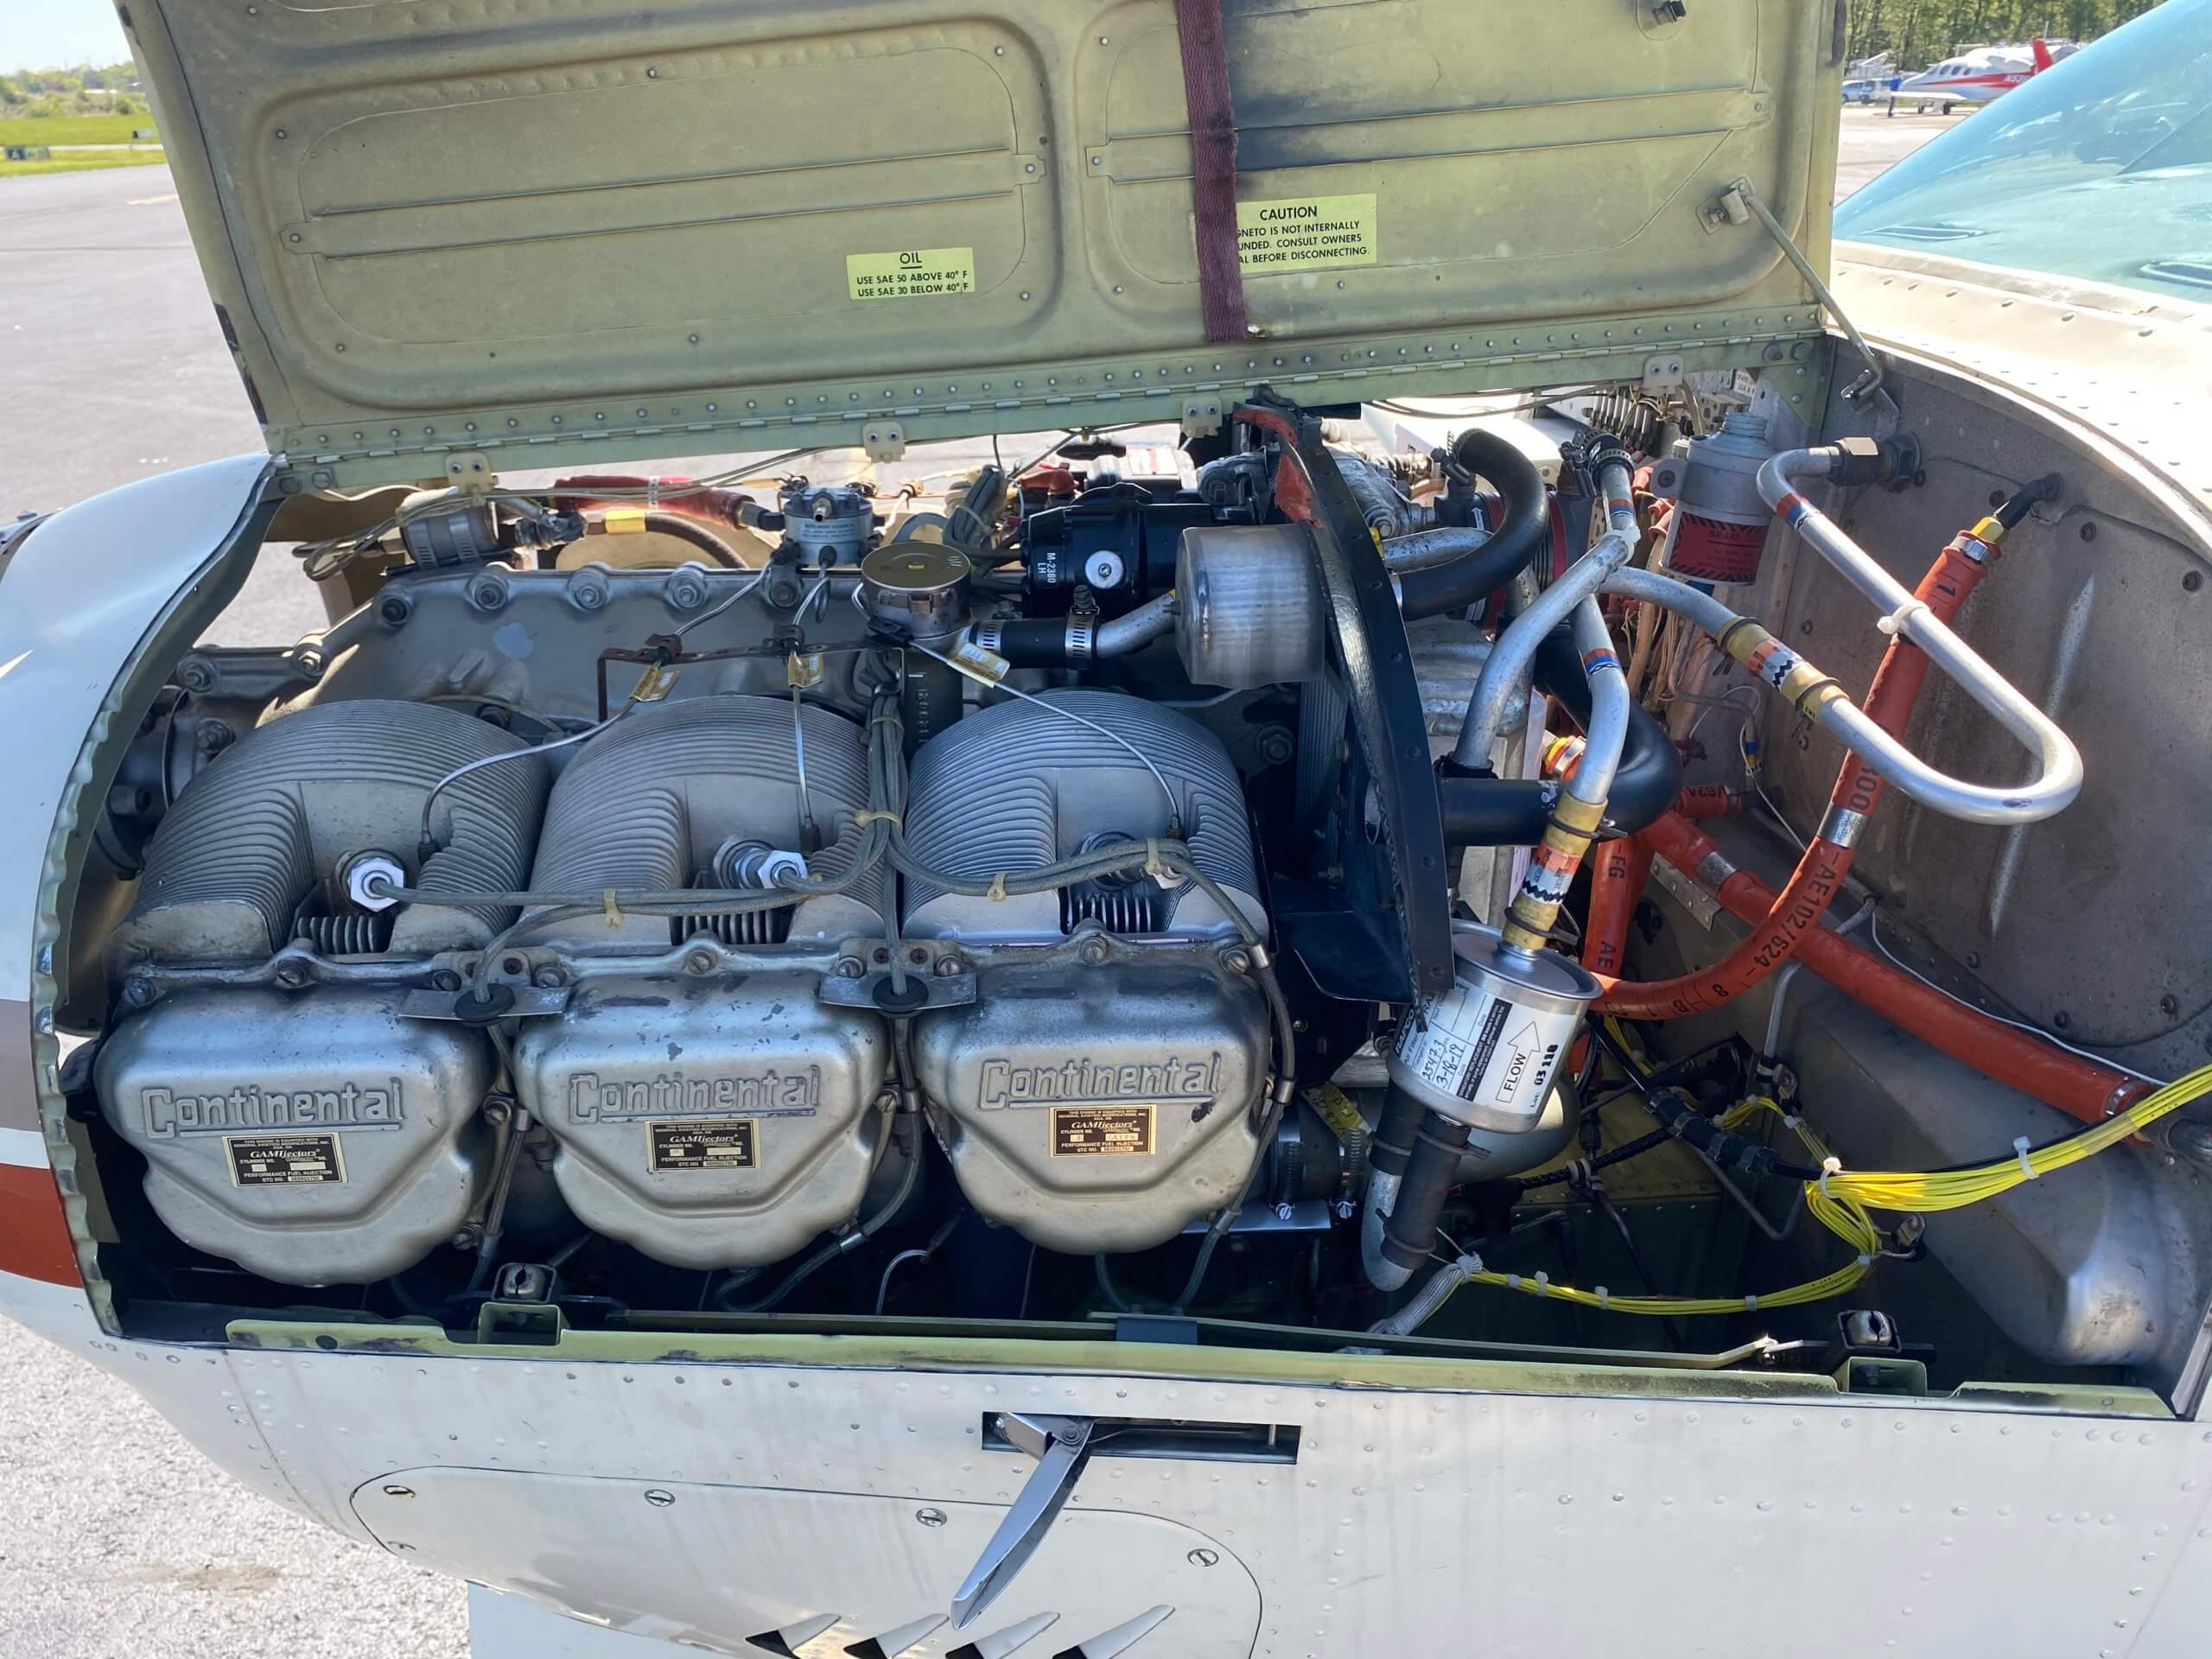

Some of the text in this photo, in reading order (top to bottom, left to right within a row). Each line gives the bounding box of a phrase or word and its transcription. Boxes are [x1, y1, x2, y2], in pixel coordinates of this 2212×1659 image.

[1260, 206, 1318, 220] CAUTION
[1236, 220, 1360, 238] GNETO IS NOT INTERNALLY
[1238, 233, 1362, 251] UNDED. CONSULT OWNERS
[899, 252, 923, 264] OIL
[1253, 253, 1287, 263] BEFORE
[1291, 246, 1370, 260] DISCONNECTING.
[856, 276, 873, 284] USE
[877, 275, 893, 283] SAE
[897, 274, 907, 283] 50
[910, 271, 942, 282] ABOVE
[878, 287, 894, 296] SAE
[898, 286, 907, 295] 30
[911, 284, 943, 294] BELOW
[963, 283, 969, 291] F
[1038, 563, 1046, 574] LH
[1503, 1053, 1526, 1090] FLOW
[977, 1051, 1223, 1111] Continental
[568, 1064, 822, 1125] Continental
[141, 1076, 404, 1140] Continental
